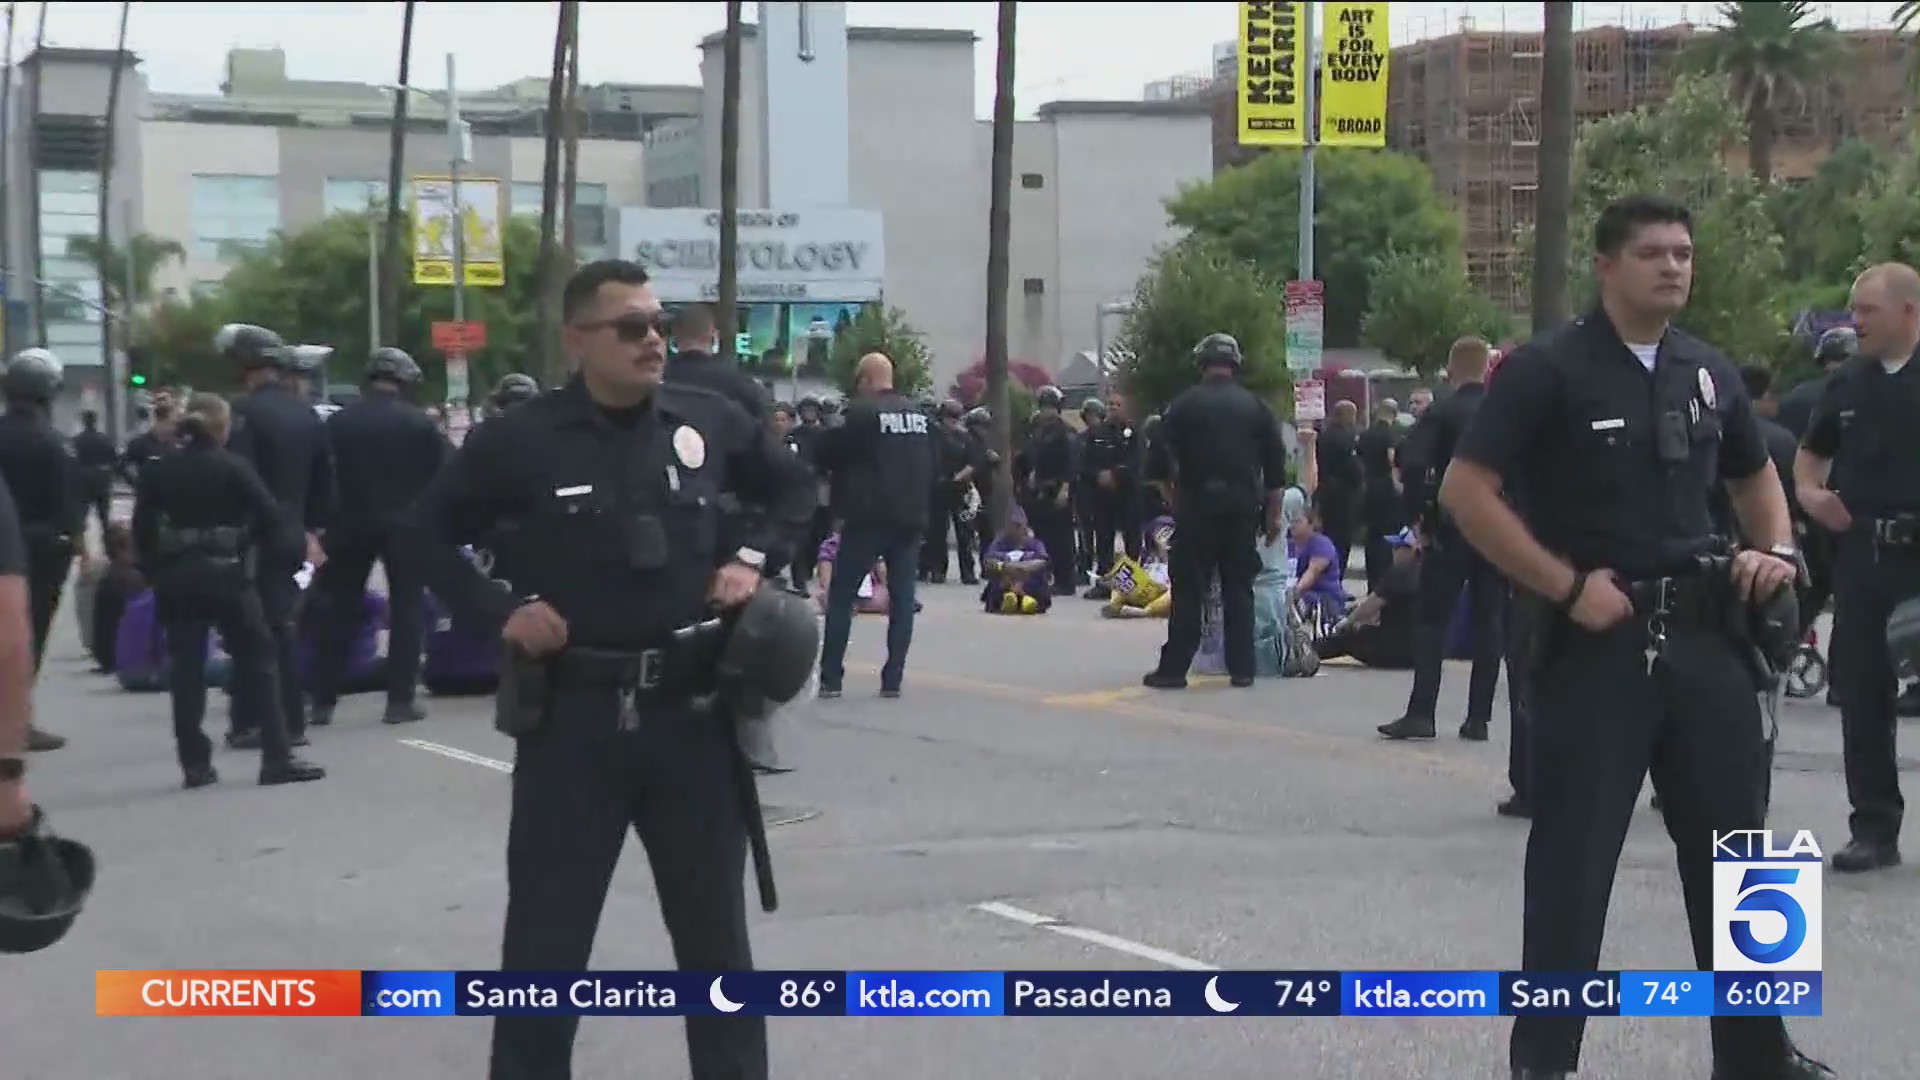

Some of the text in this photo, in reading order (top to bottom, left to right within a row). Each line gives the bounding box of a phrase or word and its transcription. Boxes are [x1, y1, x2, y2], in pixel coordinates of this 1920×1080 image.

[1339, 9, 1374, 24] ART
[1349, 25, 1366, 39] IS
[1248, 2, 1271, 104] KEITH
[1339, 39, 1374, 53] FOR
[1327, 53, 1385, 68] EVERY
[1331, 68, 1380, 83] BODY
[1337, 117, 1382, 134] BROAD
[703, 212, 774, 228] CRCH
[879, 412, 928, 434] POLICE
